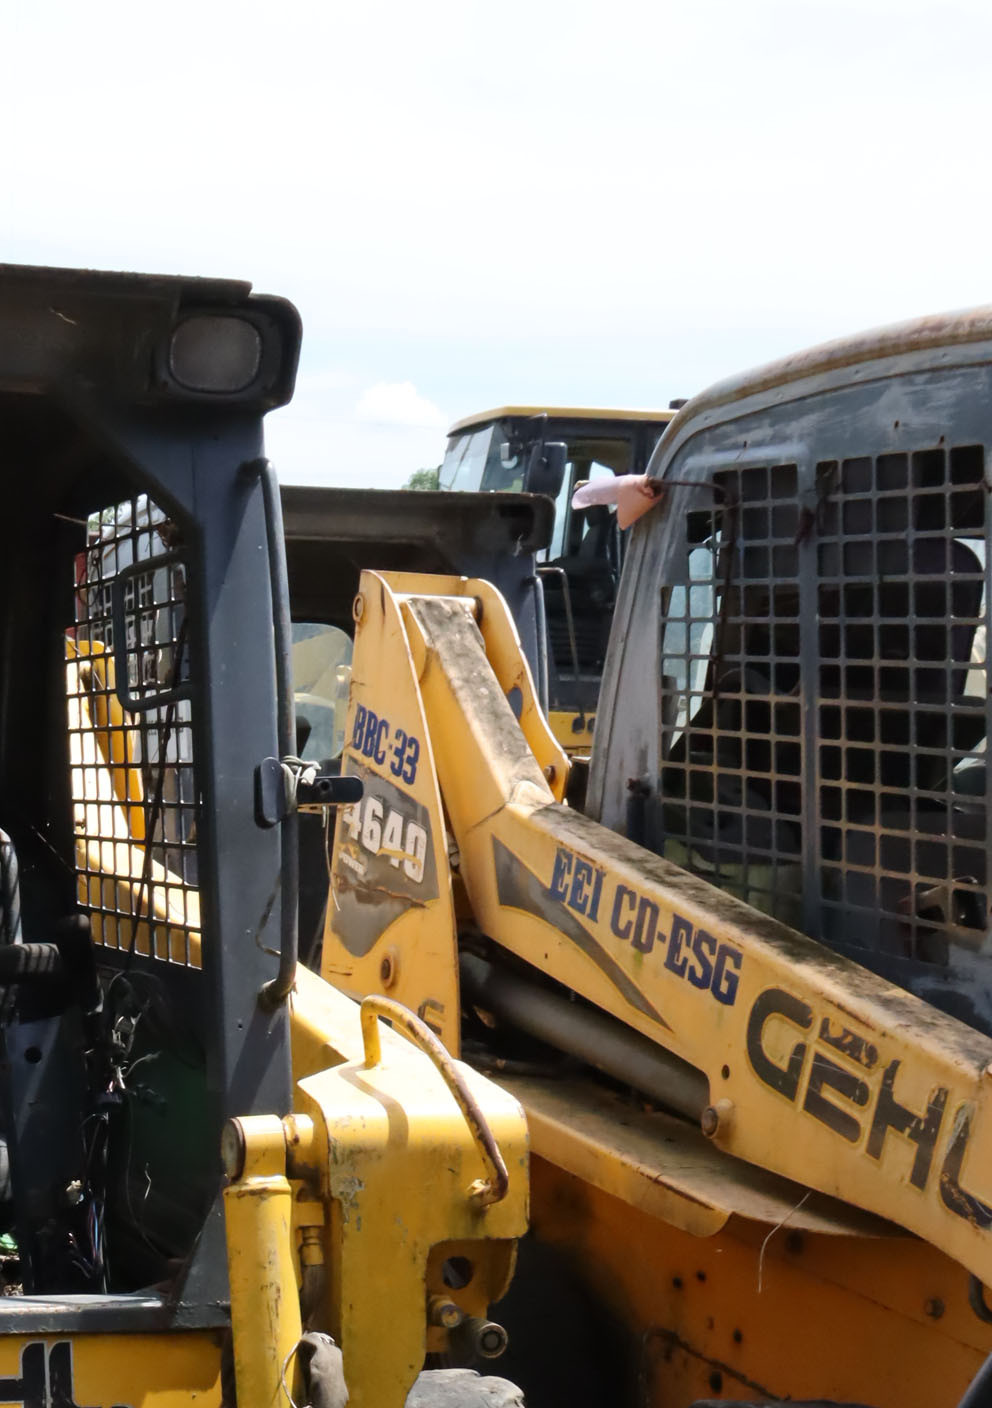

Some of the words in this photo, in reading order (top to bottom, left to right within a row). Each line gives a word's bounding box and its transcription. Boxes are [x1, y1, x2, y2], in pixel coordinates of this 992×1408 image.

[343, 796, 427, 884] 4640
[549, 847, 605, 923] EEI
[610, 884, 743, 1006] CD-ESG
[746, 988, 992, 1228] GEHL
